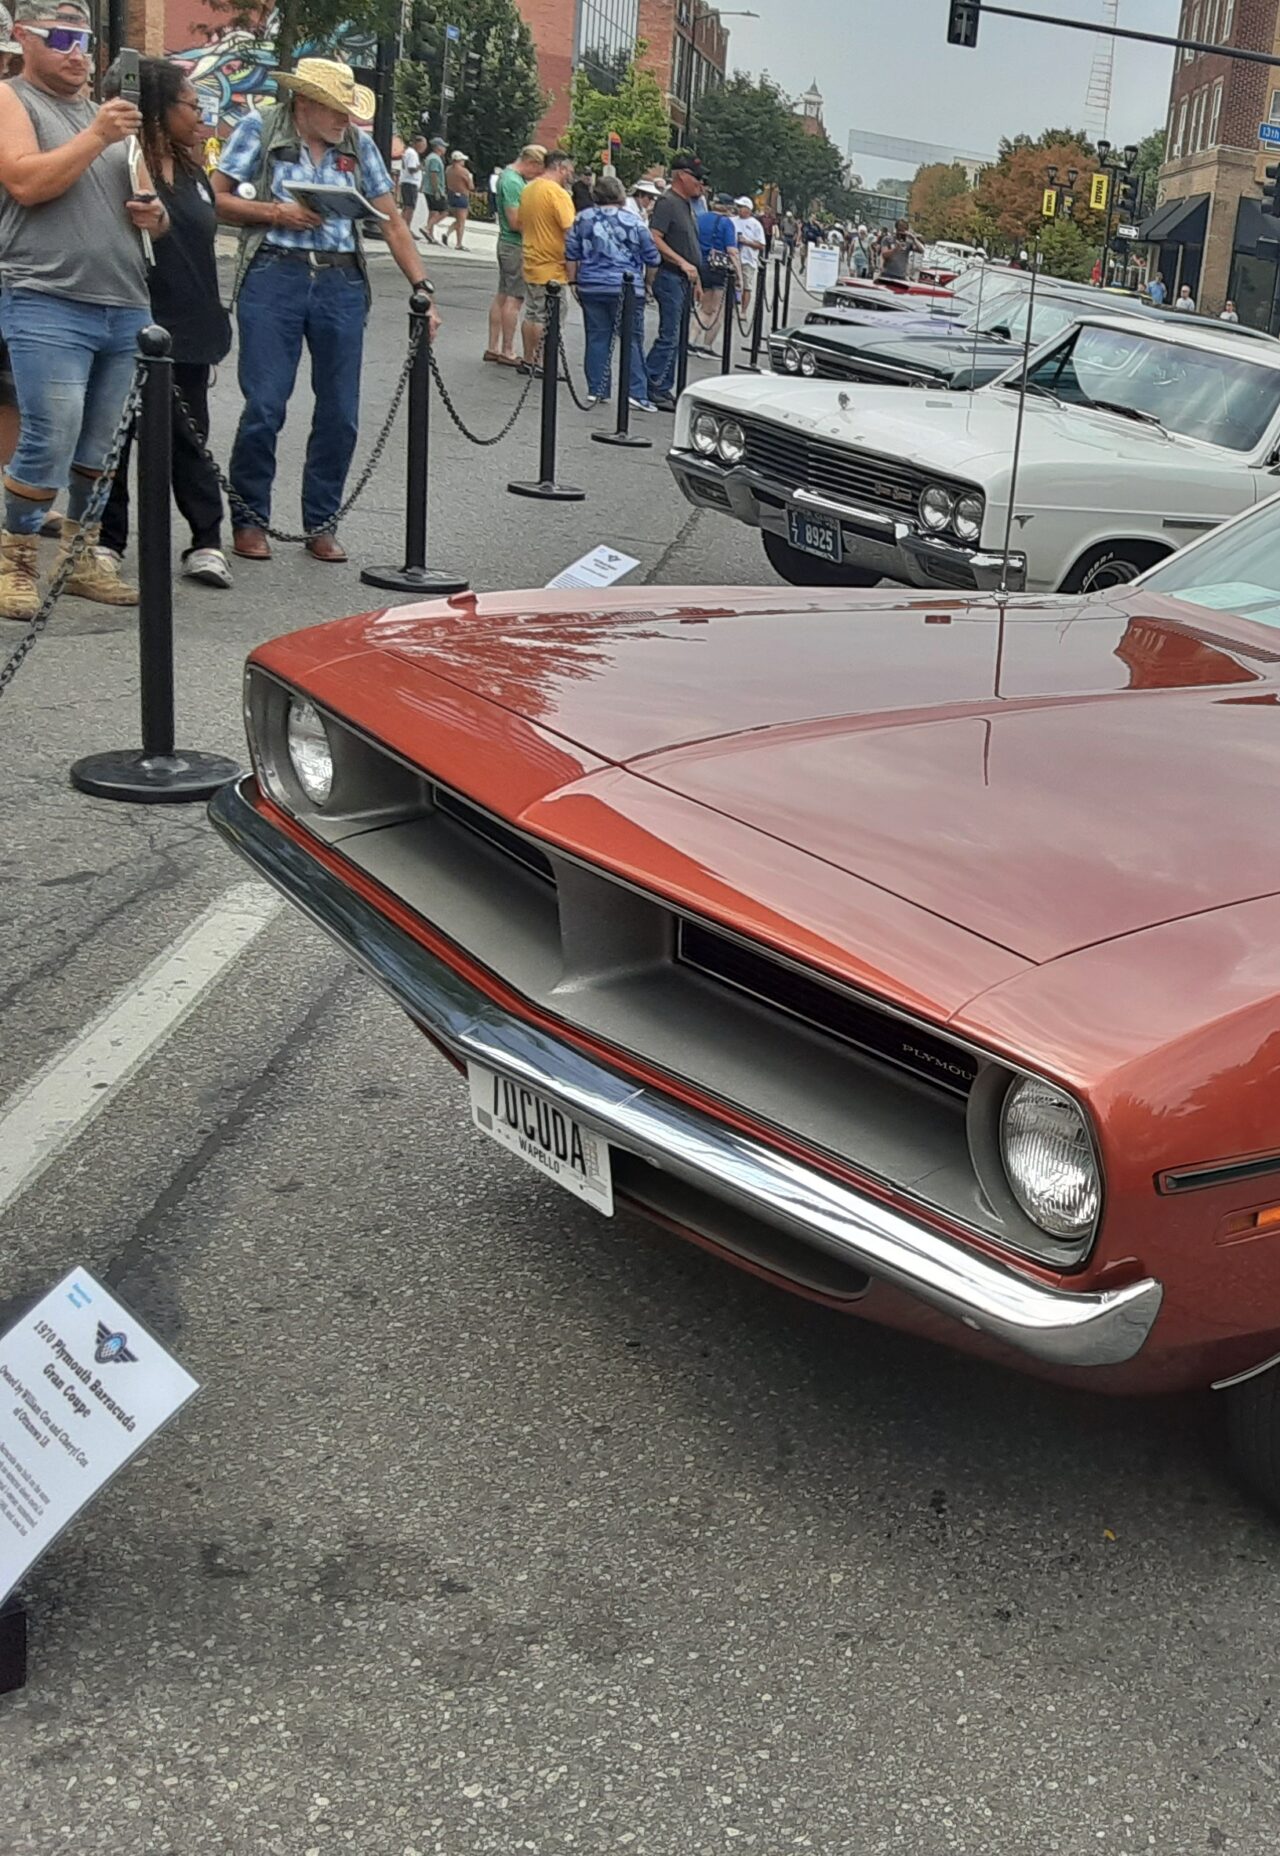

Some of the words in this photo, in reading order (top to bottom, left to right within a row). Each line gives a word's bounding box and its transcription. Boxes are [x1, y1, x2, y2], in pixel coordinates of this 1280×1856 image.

[1262, 126, 1280, 139] 13th
[805, 524, 833, 551] 8925
[902, 1043, 976, 1081] PLYMOU
[519, 1136, 560, 1174] WAPELLO
[33, 1320, 57, 1343] 1970
[51, 1338, 92, 1385] Plymouth
[89, 1379, 136, 1433] Barracuda
[43, 1363, 65, 1390] Gran
[63, 1385, 91, 1418] Coupe
